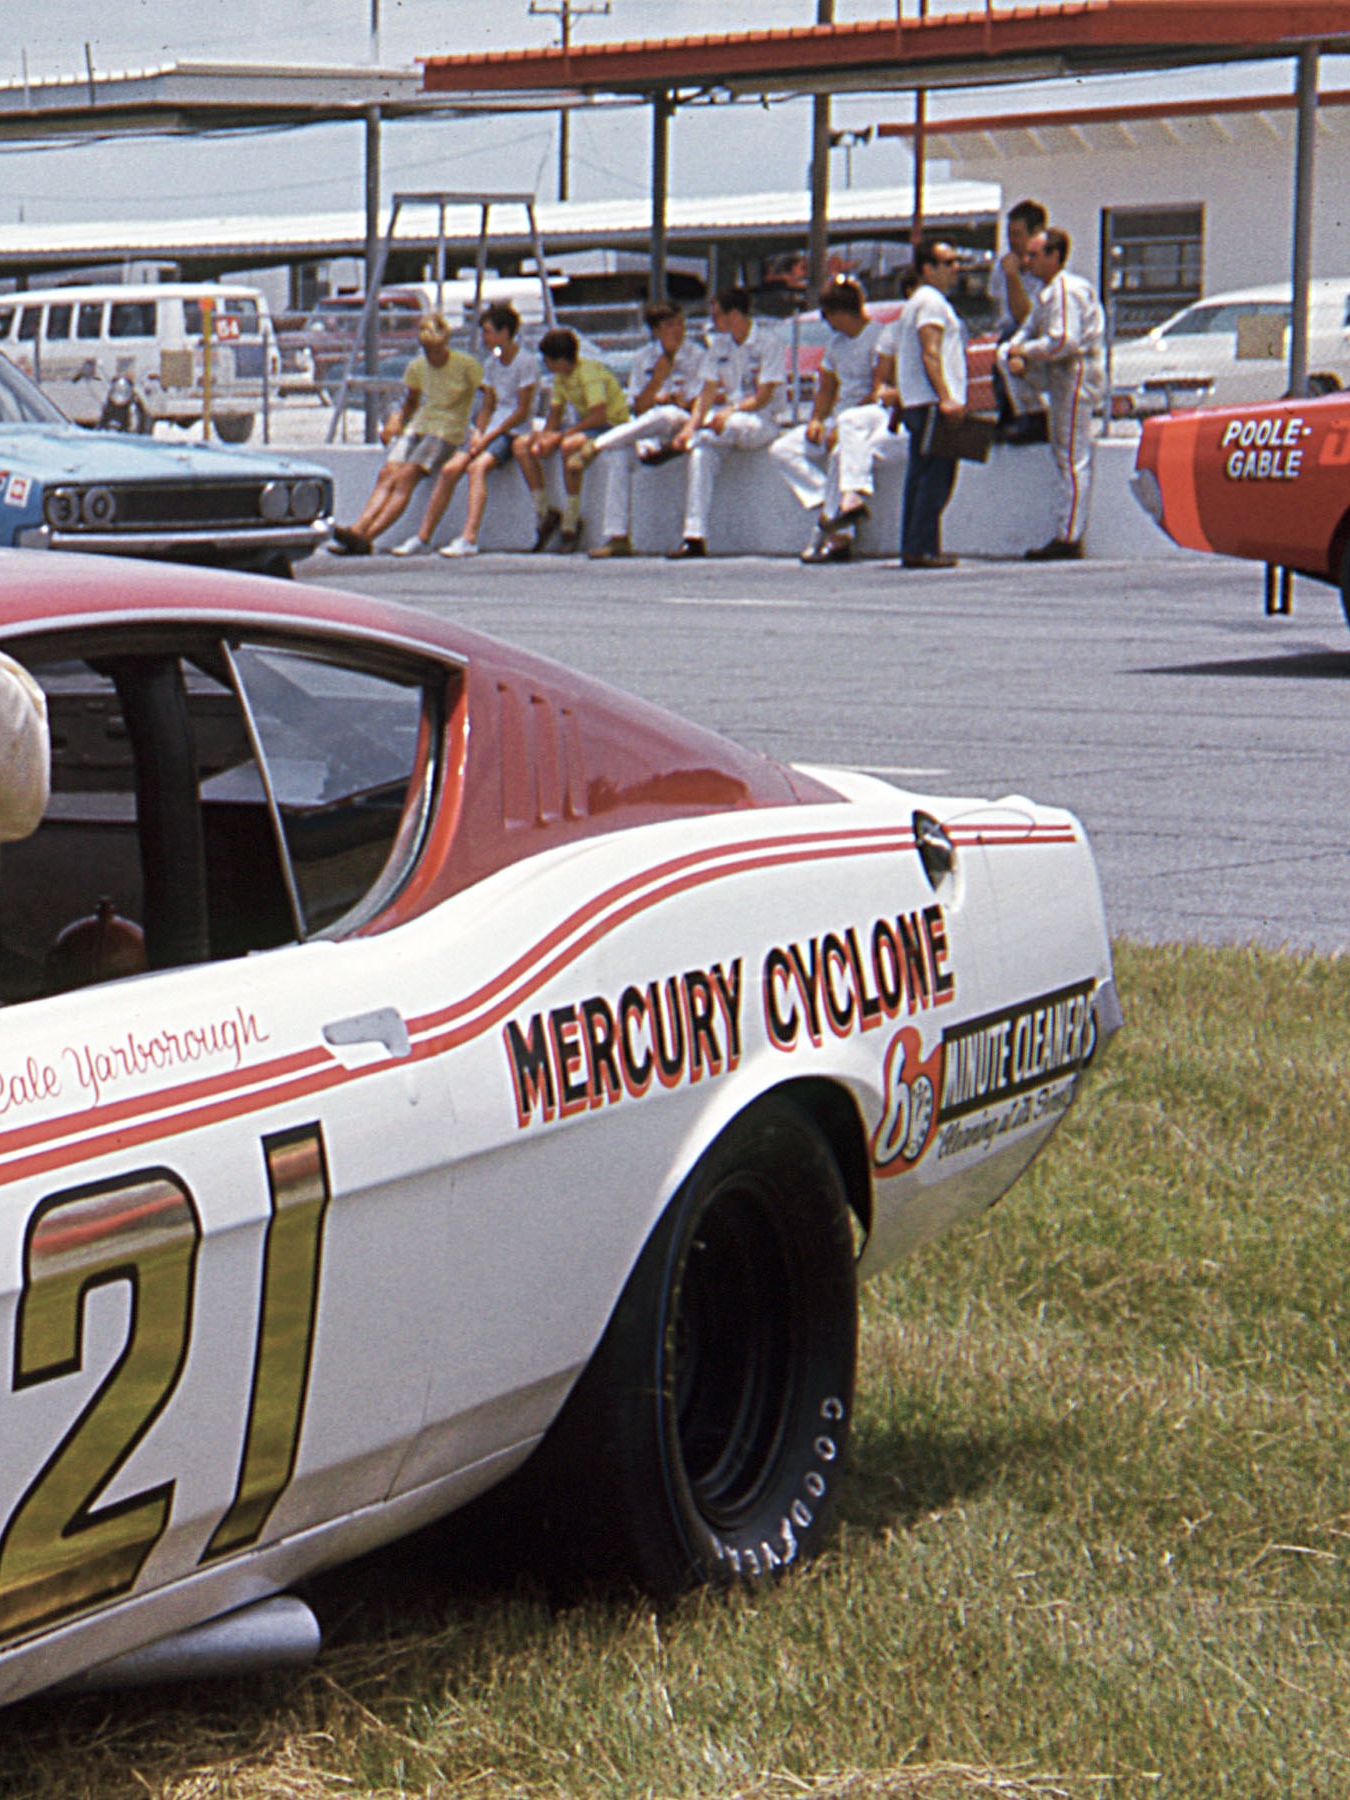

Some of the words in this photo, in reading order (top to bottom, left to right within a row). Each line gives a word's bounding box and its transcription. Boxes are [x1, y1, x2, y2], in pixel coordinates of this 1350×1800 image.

[1226, 449, 1305, 478] GABLE
[62, 1006, 270, 1109] Yarborough
[503, 957, 744, 1129] MERCURY
[762, 903, 956, 1053] CYCLONE
[941, 1019, 1014, 1110] MINUTE
